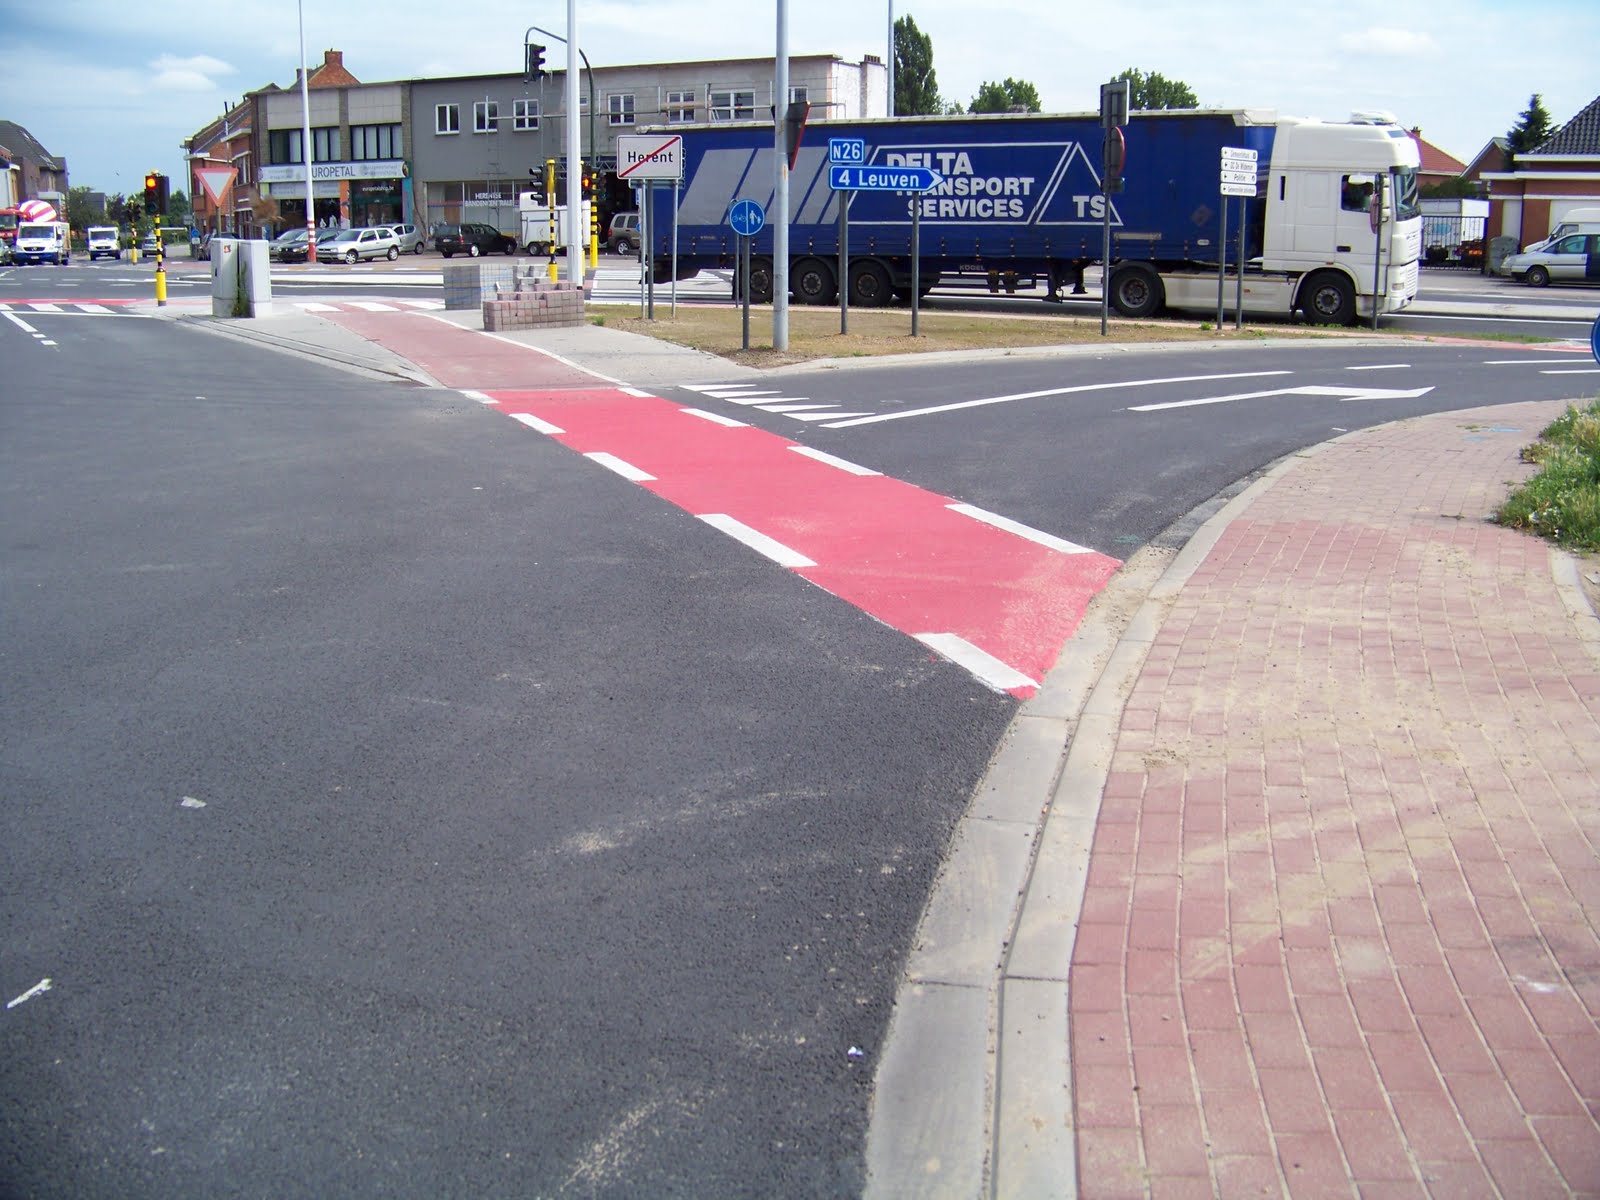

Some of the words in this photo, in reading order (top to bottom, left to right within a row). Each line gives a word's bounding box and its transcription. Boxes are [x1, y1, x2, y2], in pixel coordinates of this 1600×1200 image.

[627, 151, 673, 163] Herent
[833, 143, 861, 160] N26
[311, 165, 356, 178] UROPETAL
[887, 152, 974, 175] DELTA
[838, 170, 850, 186] 4
[858, 171, 919, 187] Leuven
[897, 177, 1034, 196] NSPORT
[907, 199, 1024, 218] SERVICES
[1072, 195, 1106, 218] TS
